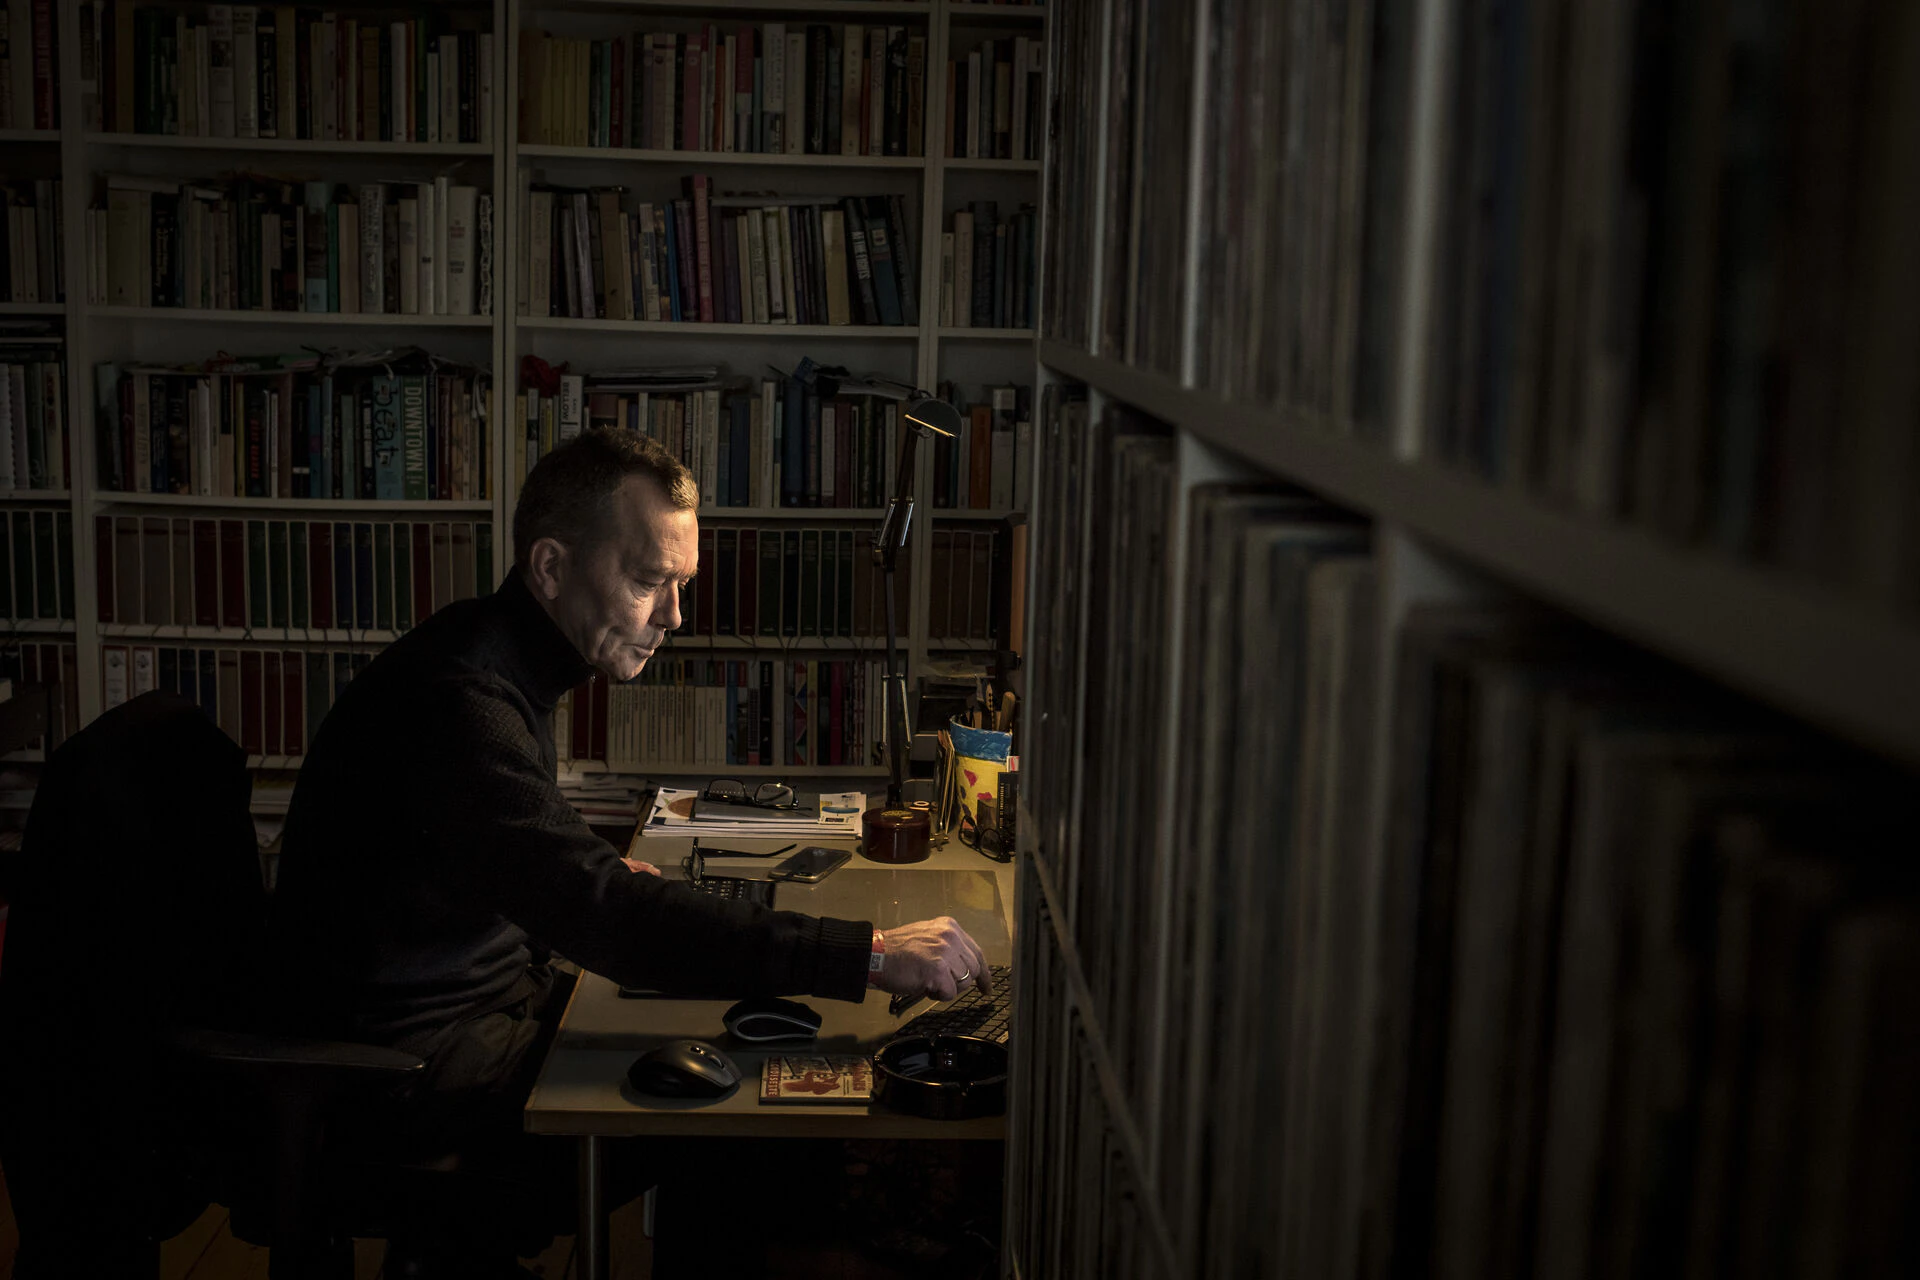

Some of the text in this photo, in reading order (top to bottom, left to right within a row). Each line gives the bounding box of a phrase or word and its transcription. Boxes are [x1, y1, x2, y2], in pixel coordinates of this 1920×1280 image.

[853, 241, 867, 254] THE
[855, 254, 871, 280] FIGHTS
[562, 382, 570, 421] BELLOW
[374, 387, 401, 459] beat
[404, 386, 424, 472] DOWNTOWN
